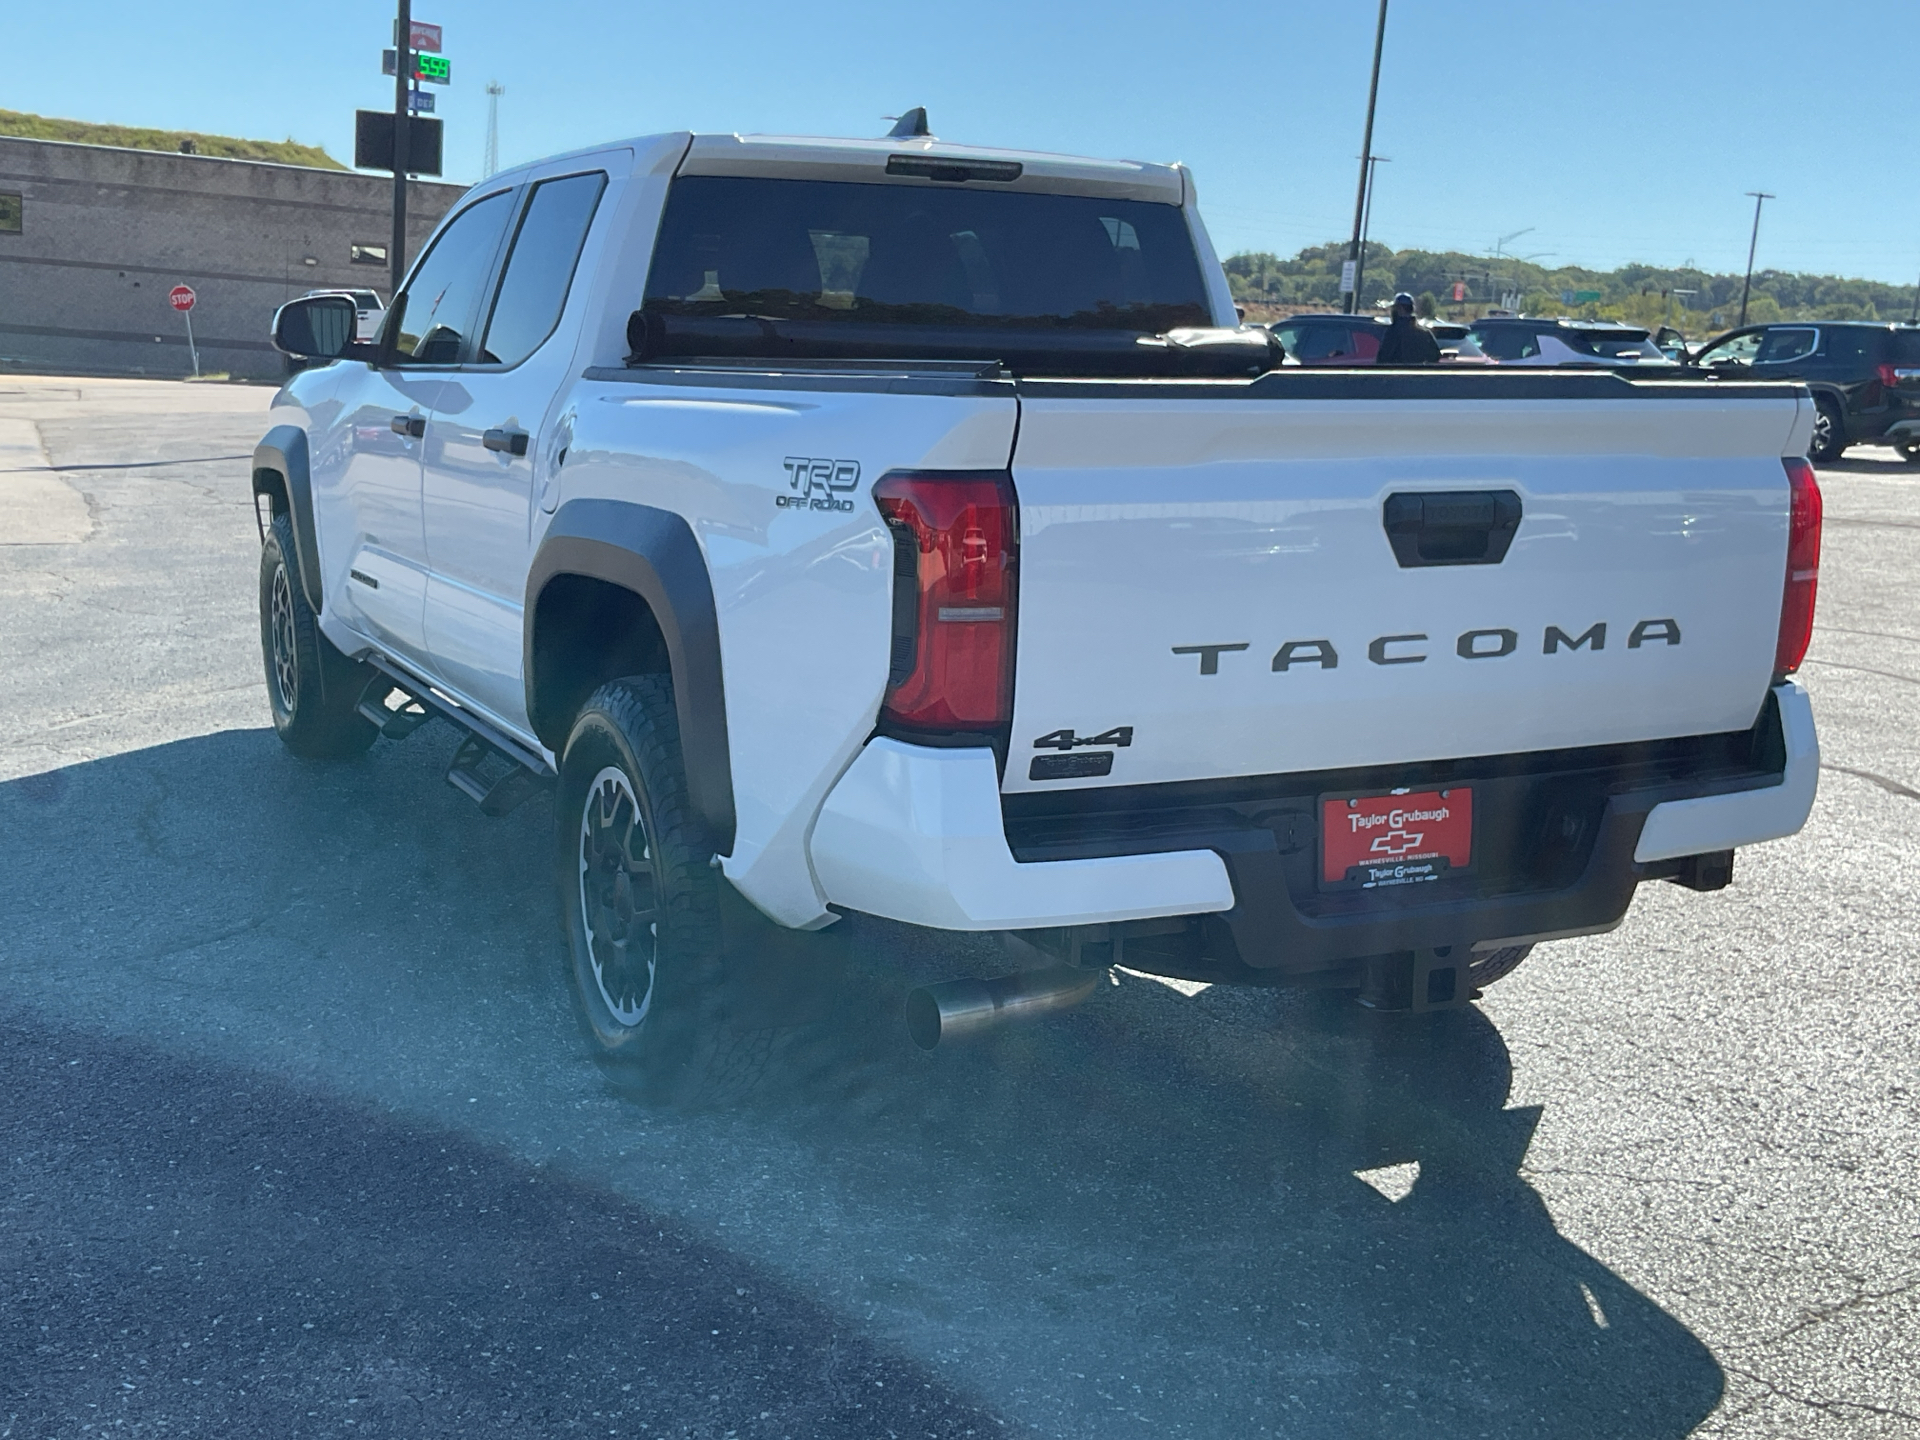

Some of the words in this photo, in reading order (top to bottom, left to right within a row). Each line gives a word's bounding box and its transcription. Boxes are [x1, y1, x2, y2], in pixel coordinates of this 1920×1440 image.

[171, 293, 193, 305] STOP
[783, 456, 861, 499] TRD
[775, 495, 809, 510] OFF
[809, 498, 855, 513] ROAD
[1171, 618, 1682, 675] TACOMA
[1347, 813, 1387, 832] Taylor
[1389, 807, 1450, 828] Grubaugh
[1408, 852, 1438, 860] MISSOURI
[1369, 868, 1393, 881] Taylor
[1395, 864, 1432, 878] Grubaugh
